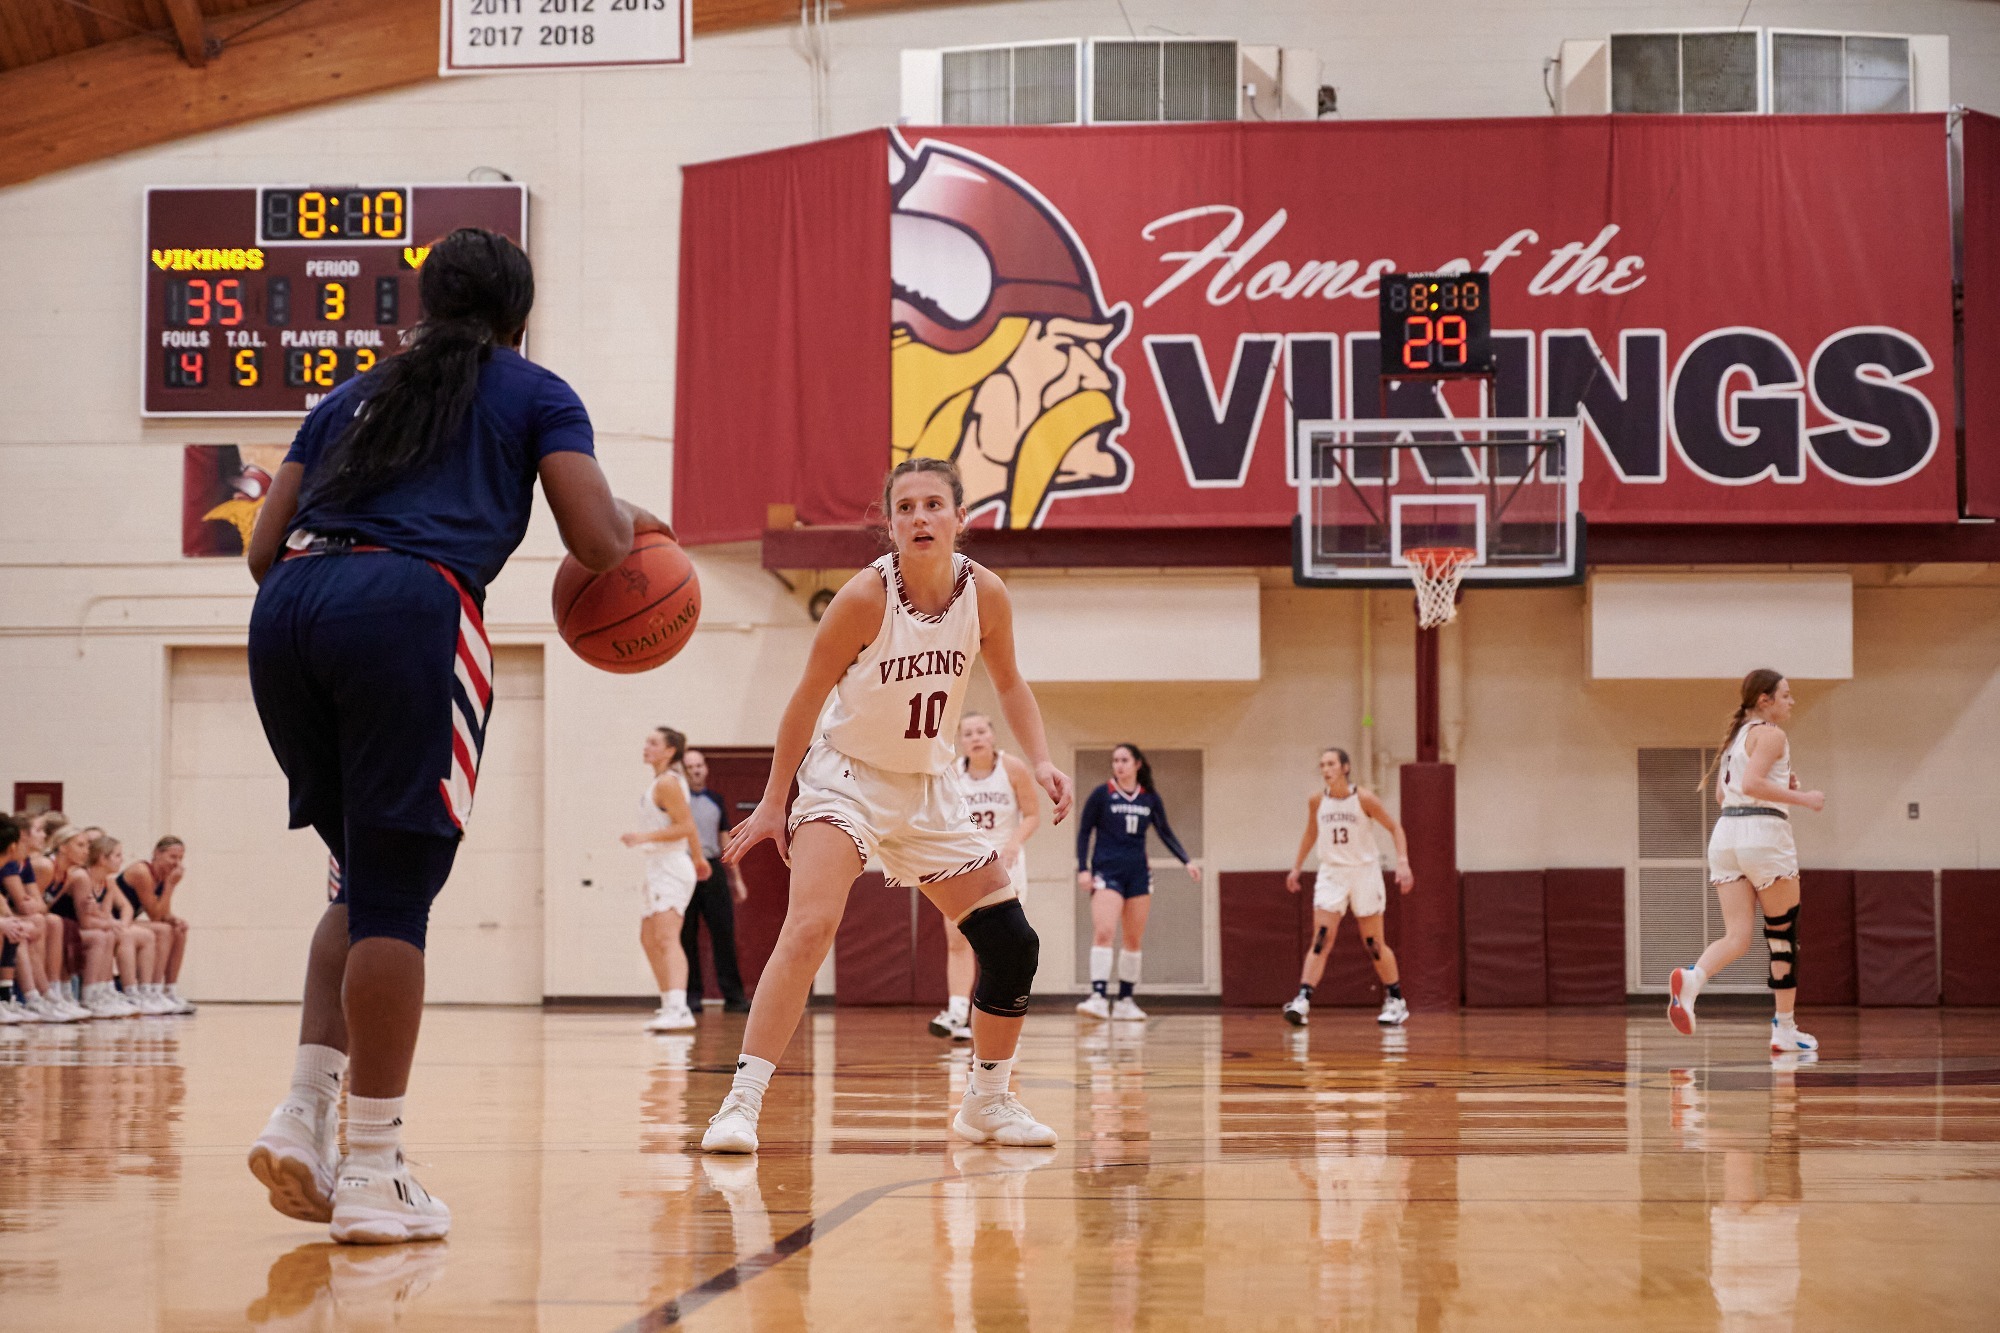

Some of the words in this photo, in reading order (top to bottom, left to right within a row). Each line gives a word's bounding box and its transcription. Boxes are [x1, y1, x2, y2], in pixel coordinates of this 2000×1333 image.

[469, 27, 523, 46] 2017
[539, 25, 595, 45] 2018
[298, 191, 402, 239] 8:10
[152, 249, 265, 271] VIKINGS
[306, 260, 359, 277] PERIOD
[1142, 205, 1397, 308] Home
[1527, 223, 1647, 296] the
[187, 279, 243, 326] 35
[324, 283, 345, 321] 3
[1410, 282, 1480, 313] 8:10
[162, 330, 210, 348] FOULS
[225, 330, 267, 348] T.O.L.
[281, 330, 338, 348] PLAYER
[344, 330, 384, 347] FOUL
[1403, 315, 1468, 370] 29
[180, 353, 203, 384] 4
[235, 349, 258, 387] 5
[303, 348, 338, 387] 12
[1143, 325, 1940, 487] VIKINGS
[612, 598, 698, 659] SPALDING
[879, 650, 966, 684] VIKING
[904, 690, 948, 739] 10
[1125, 814, 1139, 834] 11
[1333, 827, 1349, 845] 13
